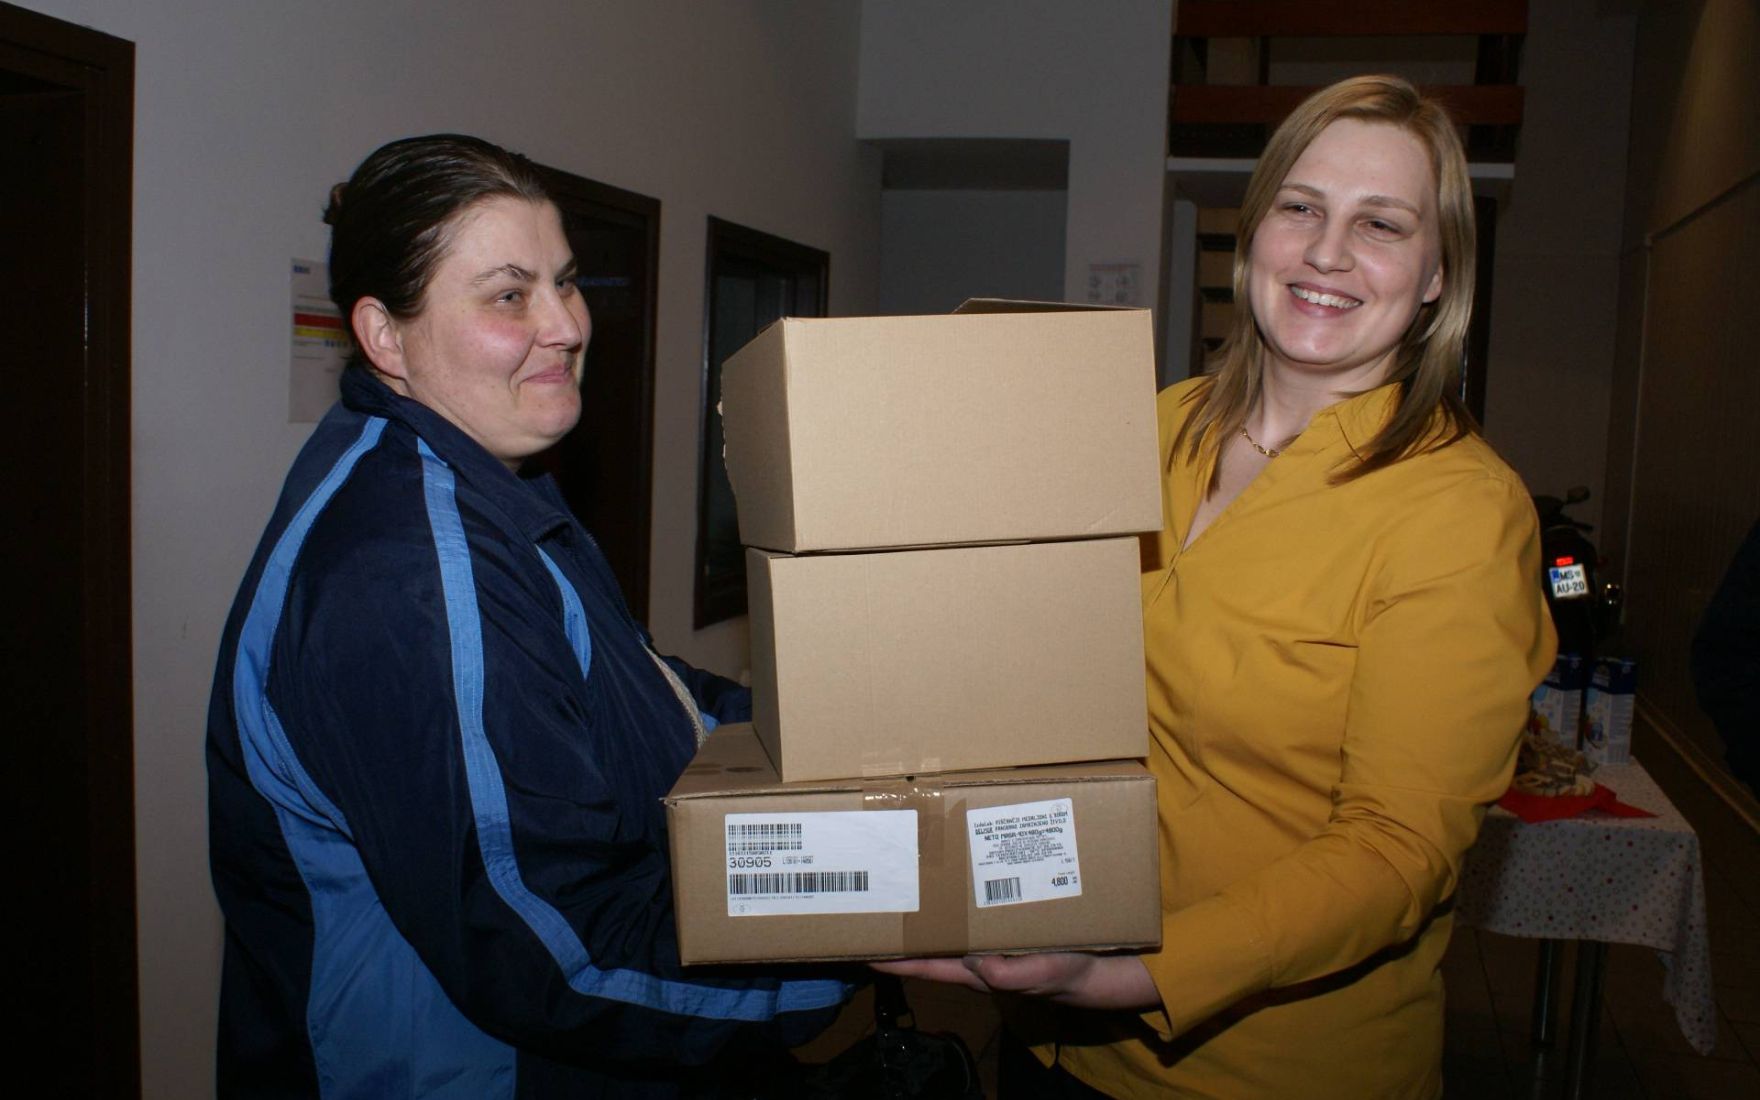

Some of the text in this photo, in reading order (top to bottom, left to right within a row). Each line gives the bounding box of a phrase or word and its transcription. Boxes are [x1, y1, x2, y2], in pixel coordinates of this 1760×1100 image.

[1560, 570, 1574, 580] MS
[729, 856, 772, 868] 30905
[1051, 876, 1069, 887] 4,800
